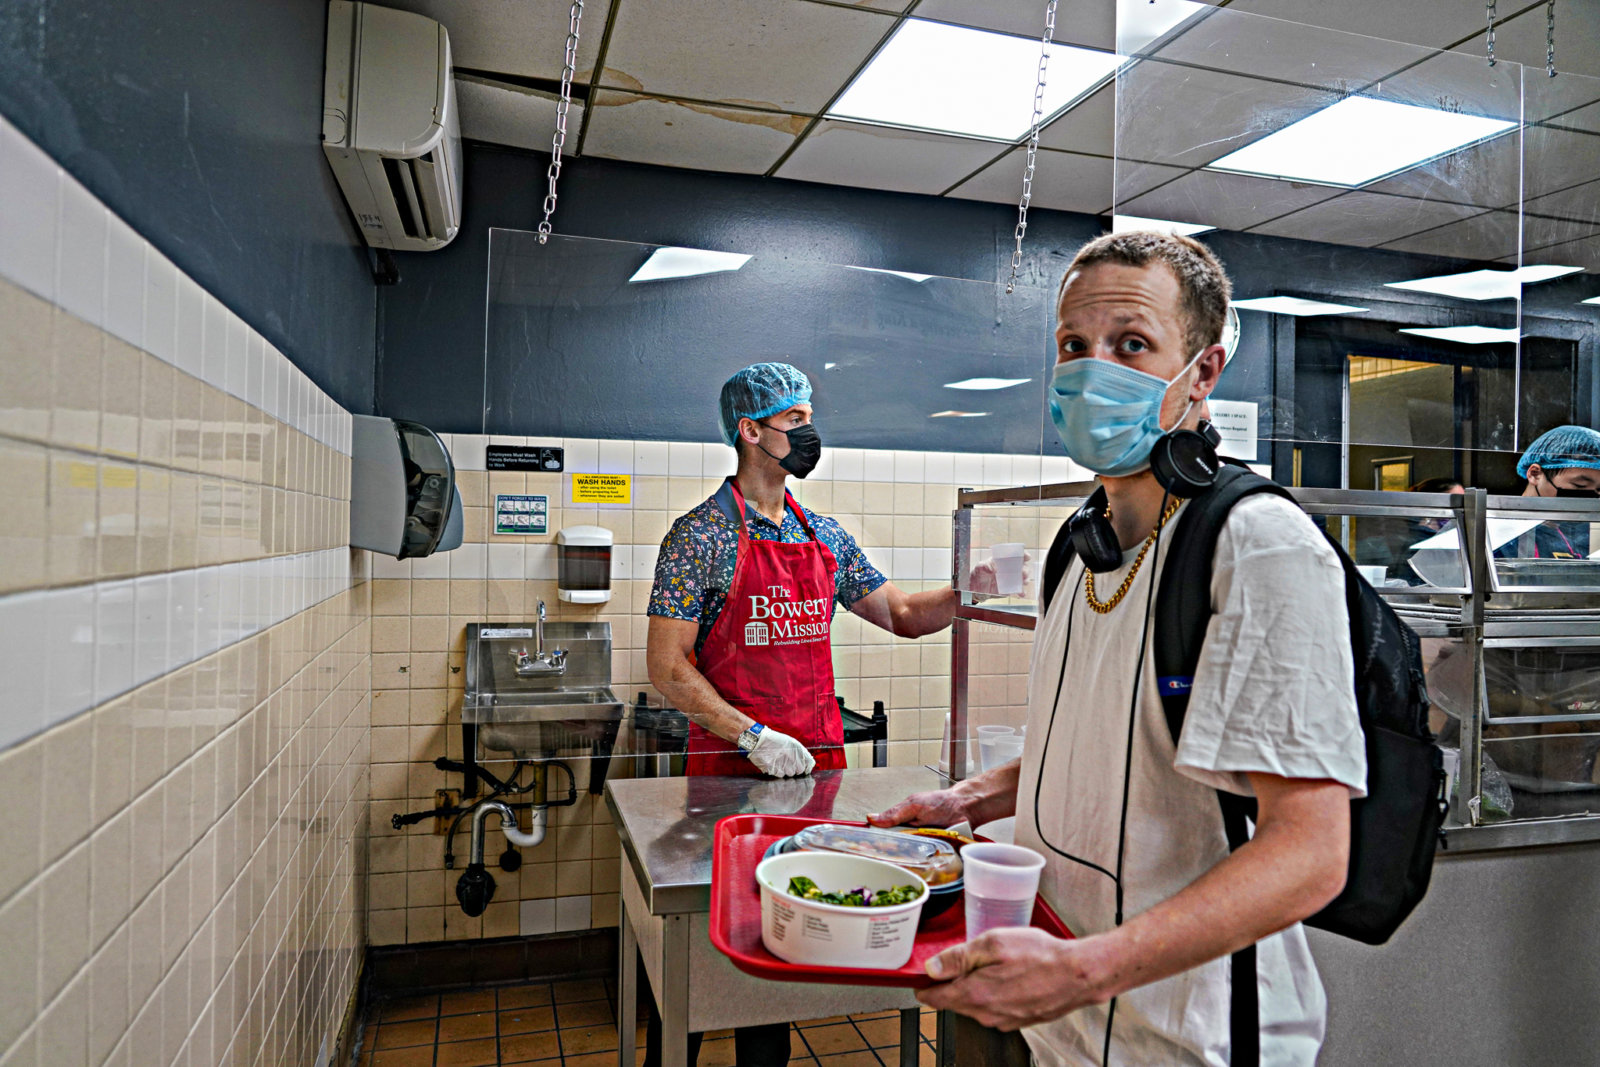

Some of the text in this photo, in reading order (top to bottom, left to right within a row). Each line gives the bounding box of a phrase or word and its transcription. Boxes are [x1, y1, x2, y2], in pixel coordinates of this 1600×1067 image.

[1196, 457, 1213, 475] SONY
[768, 585, 791, 598] The
[748, 595, 828, 620] Bowery
[771, 618, 828, 639] Mission
